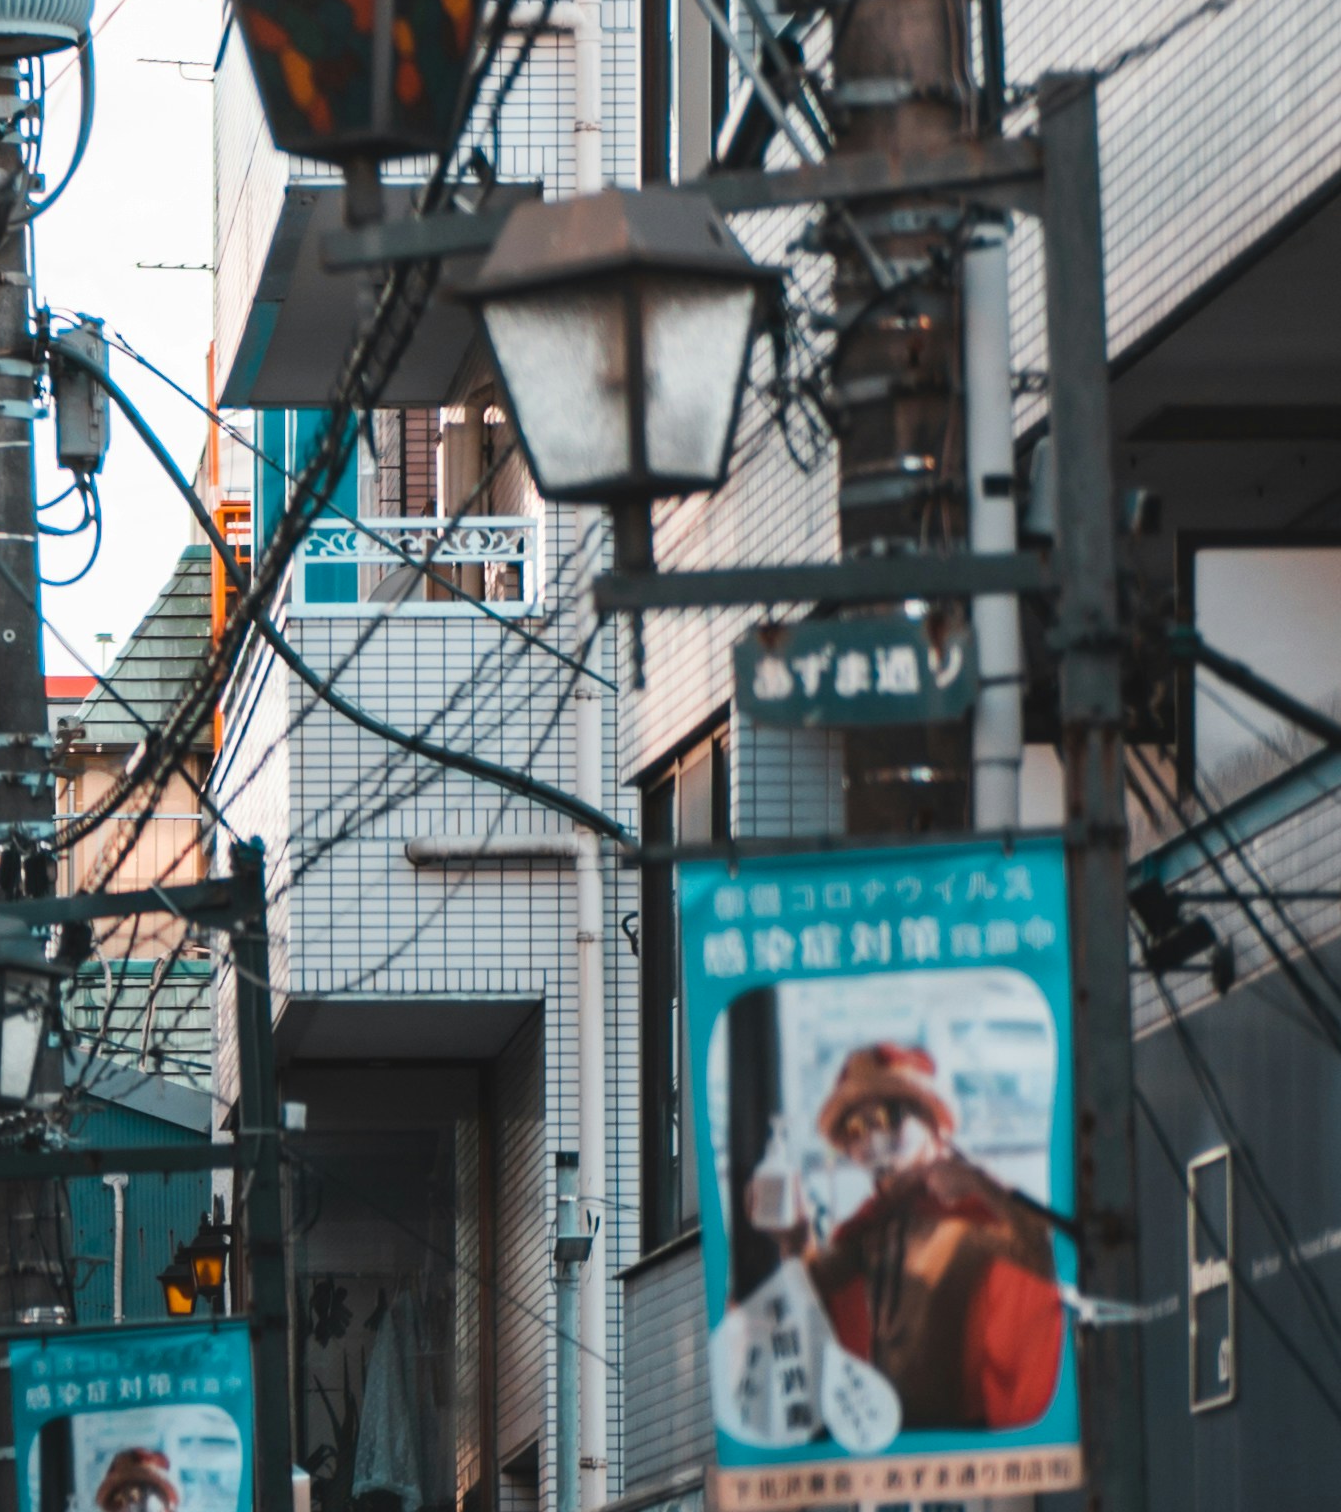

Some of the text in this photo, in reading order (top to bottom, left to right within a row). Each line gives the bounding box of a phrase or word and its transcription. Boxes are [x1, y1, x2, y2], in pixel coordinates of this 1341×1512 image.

[751, 642, 963, 701] あずま通り
[25, 1373, 172, 1410] 感染症対策
